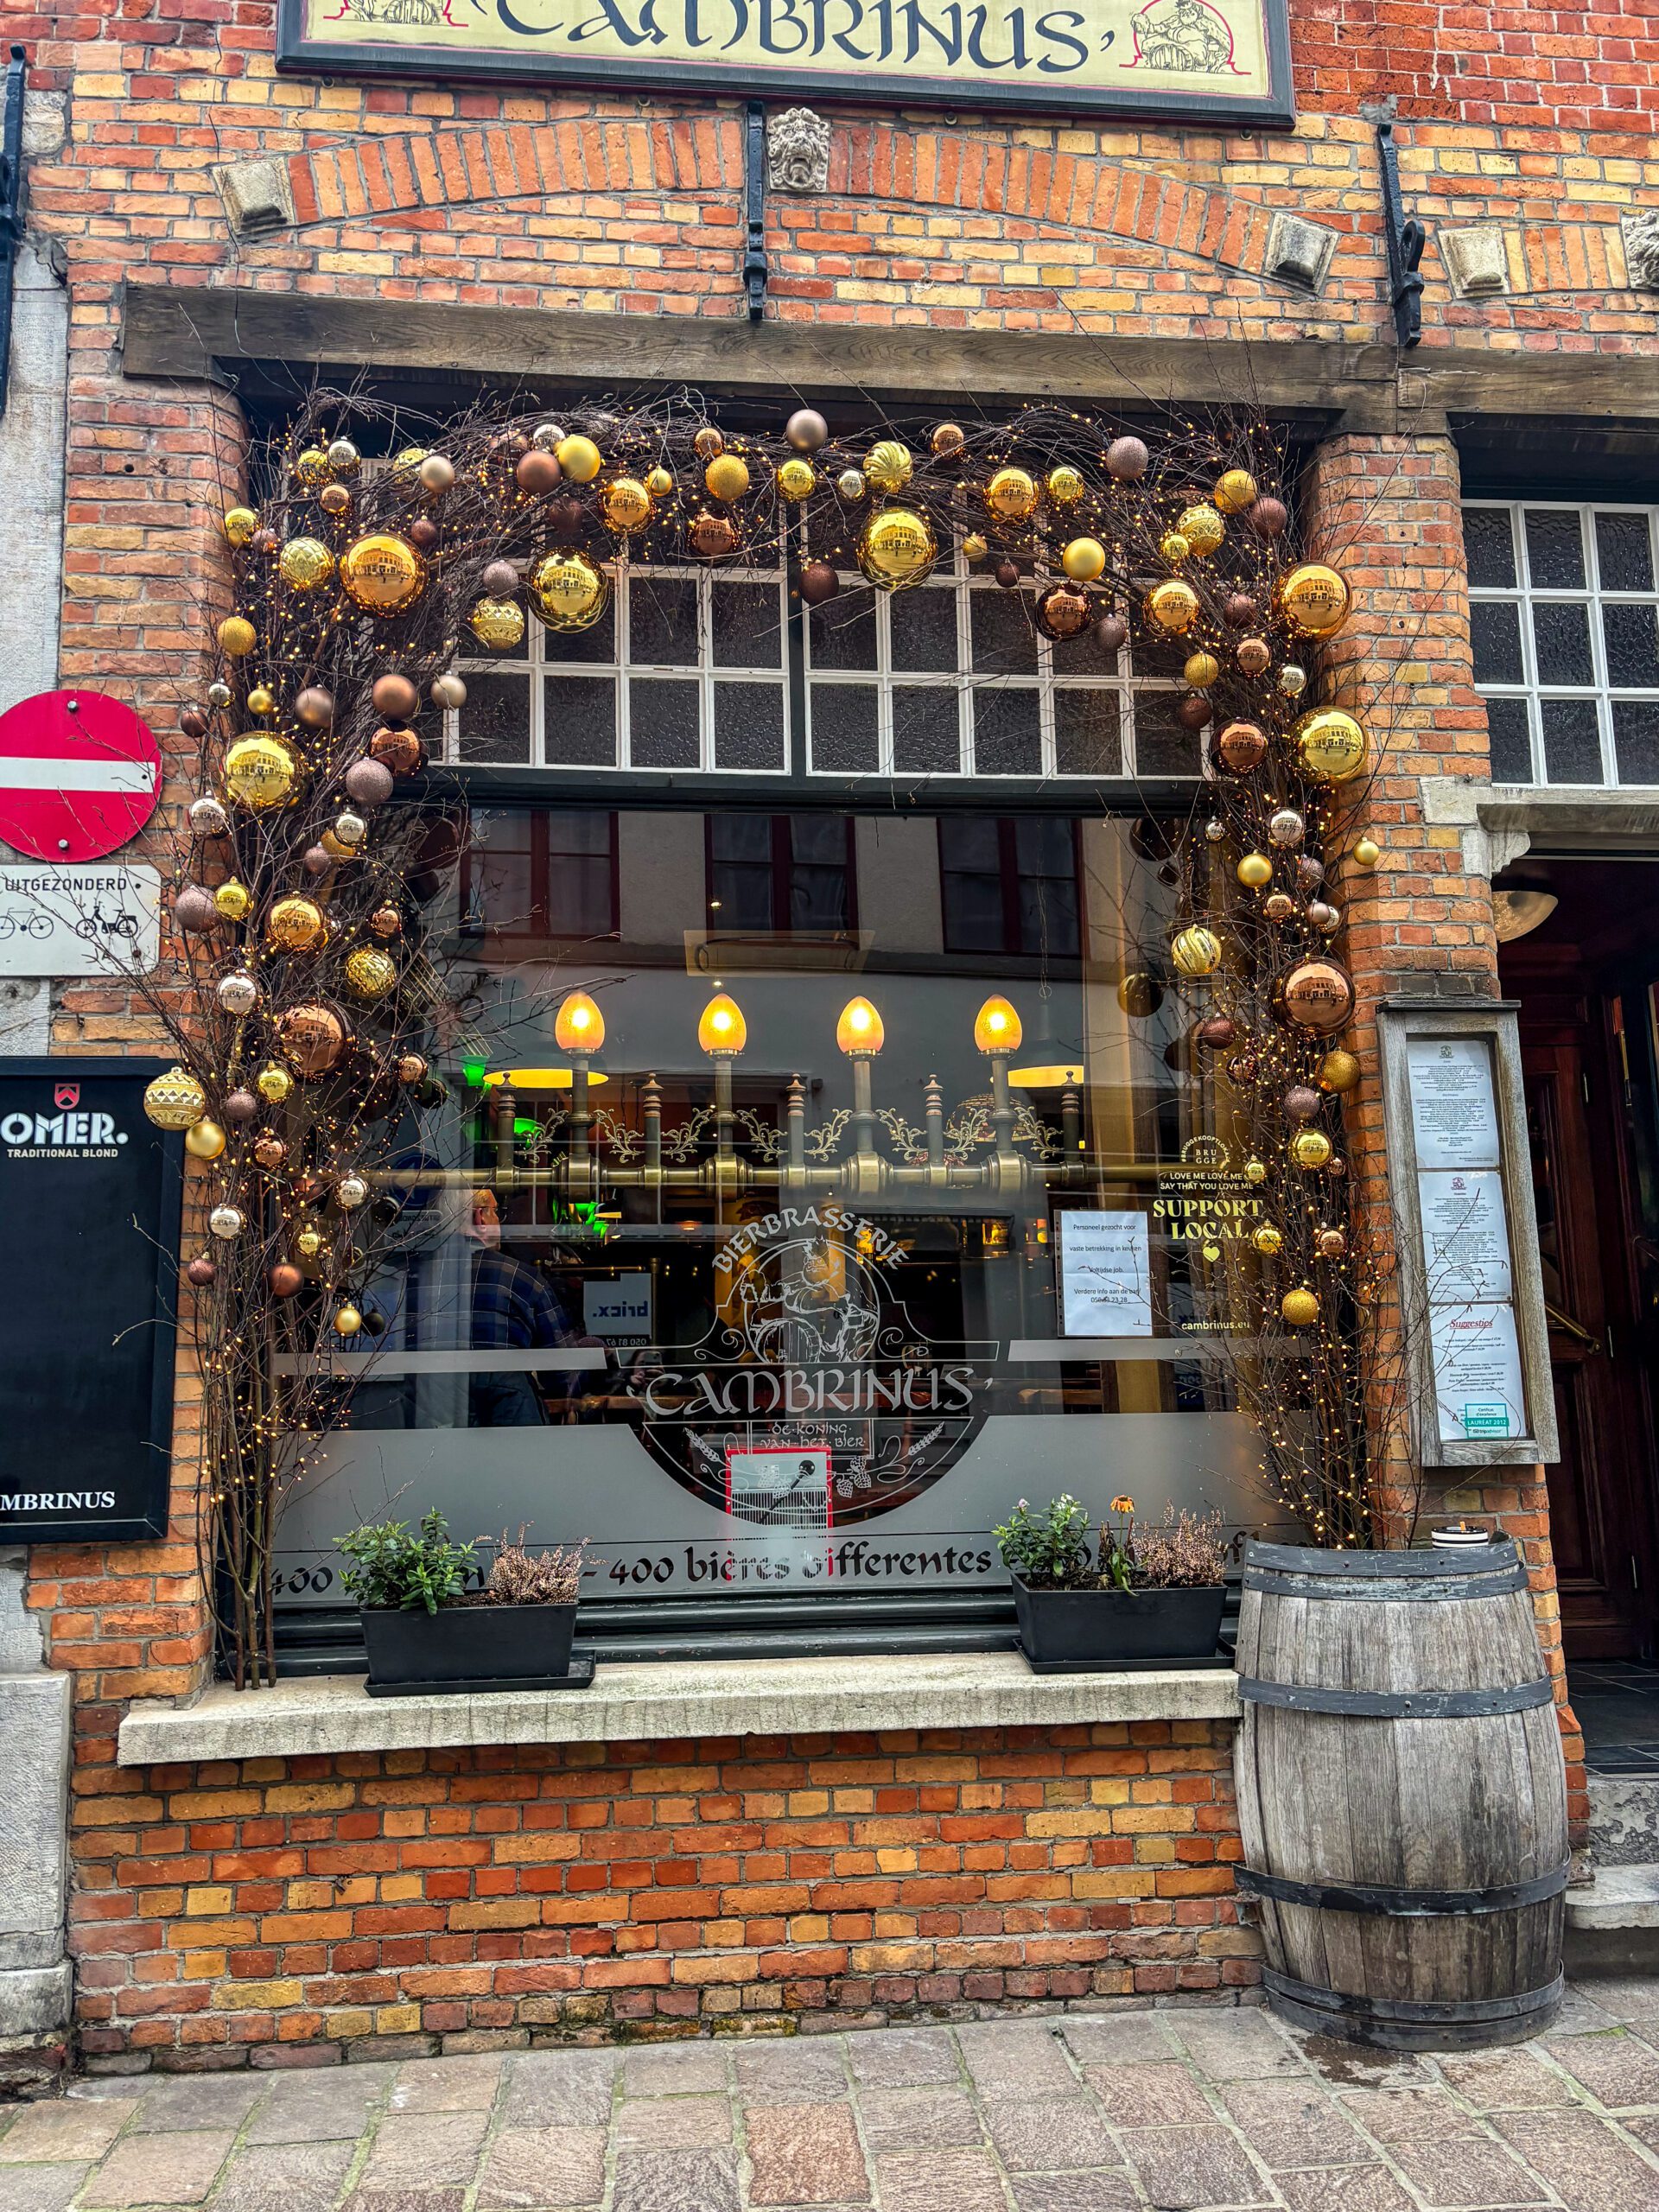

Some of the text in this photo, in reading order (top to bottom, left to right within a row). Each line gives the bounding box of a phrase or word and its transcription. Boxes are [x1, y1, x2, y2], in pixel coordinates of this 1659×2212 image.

[5, 878, 127, 892] UITGEZONDERD
[0, 1112, 129, 1145] OMER.
[7, 1148, 118, 1158] TRADITIONAL BLOND
[1153, 1199, 1263, 1217] SUPPORT
[712, 1205, 910, 1274] BIERBRASSERIE
[1171, 1221, 1249, 1240] LOCAL
[1181, 1319, 1250, 1331] cambrinus.eu
[608, 1558, 675, 1586] 400
